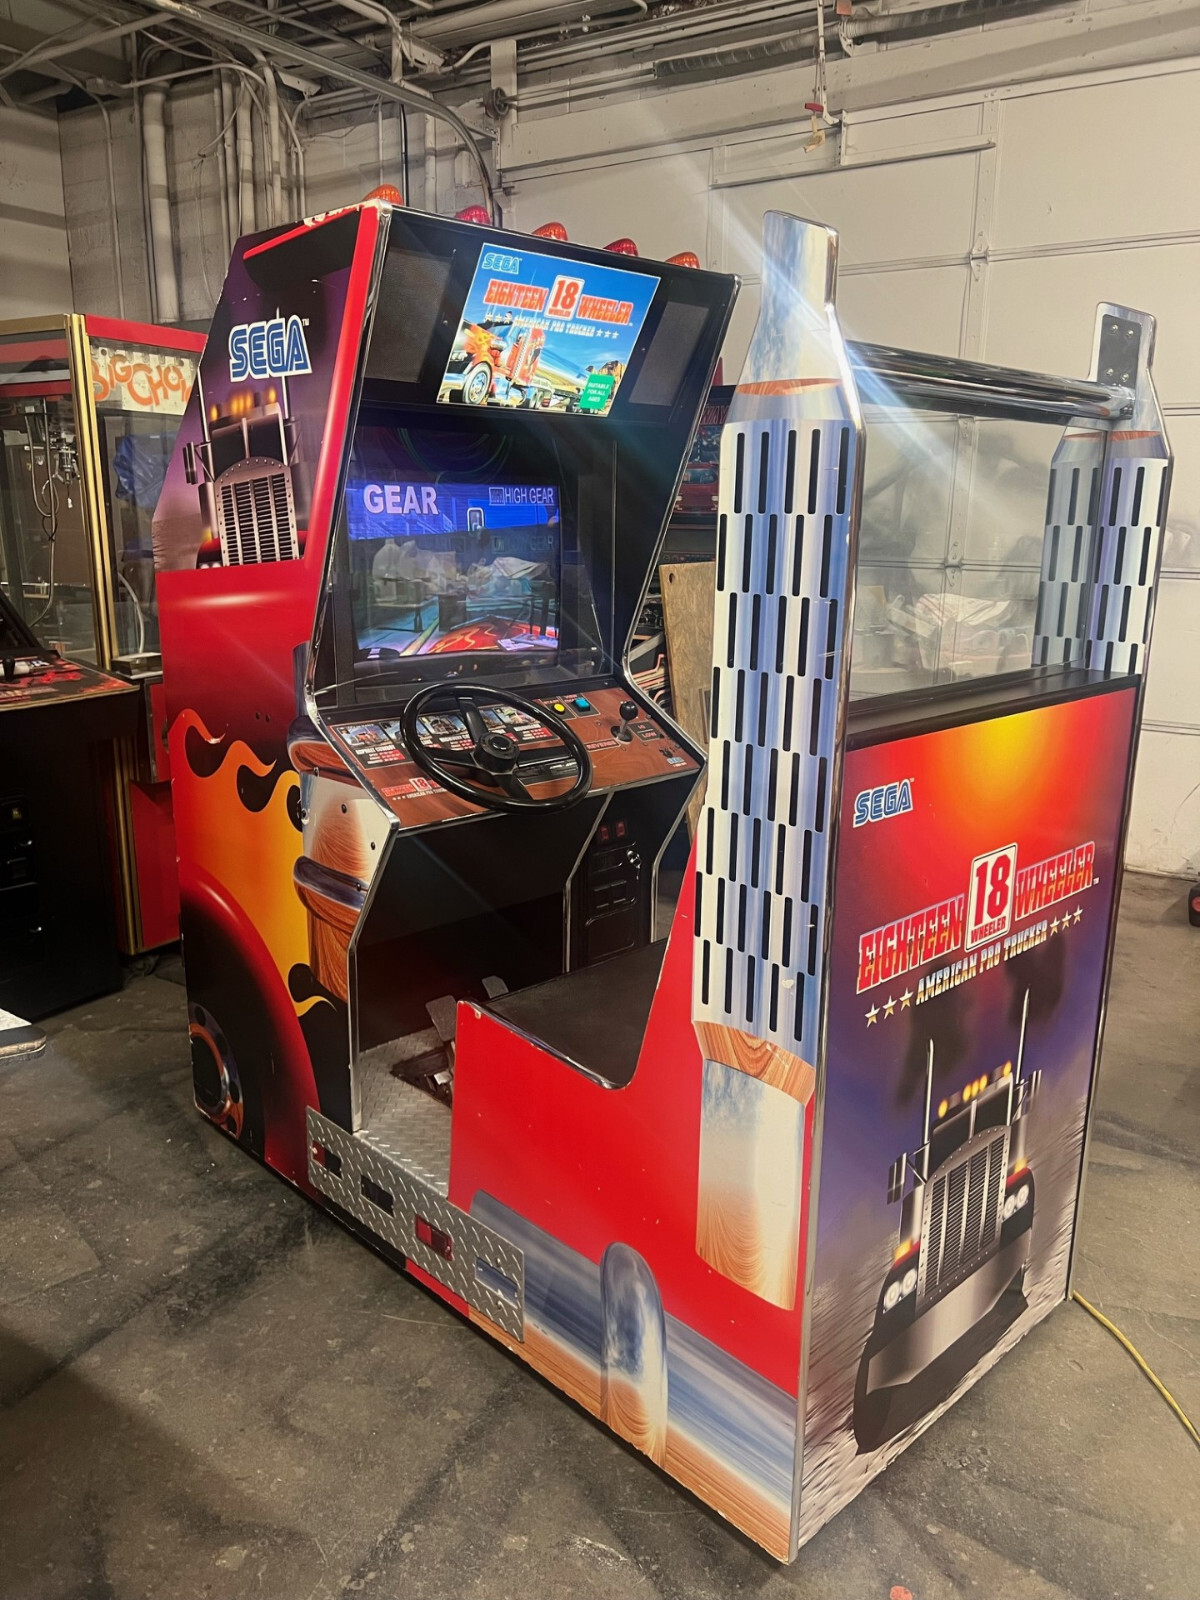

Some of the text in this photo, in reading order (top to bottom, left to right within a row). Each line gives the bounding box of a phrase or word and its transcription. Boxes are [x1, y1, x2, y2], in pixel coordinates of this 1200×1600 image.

[482, 252, 519, 274] SEGA
[483, 278, 634, 325] EIGHTEEN 18 WHEELER
[550, 320, 565, 333] PRO
[229, 315, 312, 382] SEGA
[363, 484, 439, 515] GEAR
[504, 487, 527, 504] HIGH
[529, 487, 554, 504] GEAR
[412, 778, 428, 789] 18
[853, 778, 913, 828] SEGA
[856, 893, 965, 994] EIGHTEEN
[973, 853, 1012, 928] 18
[1014, 841, 1095, 921] WHEELER
[970, 916, 1006, 943] WHEELER
[915, 920, 1048, 1005] AMERICAN PRO TRUCKER
